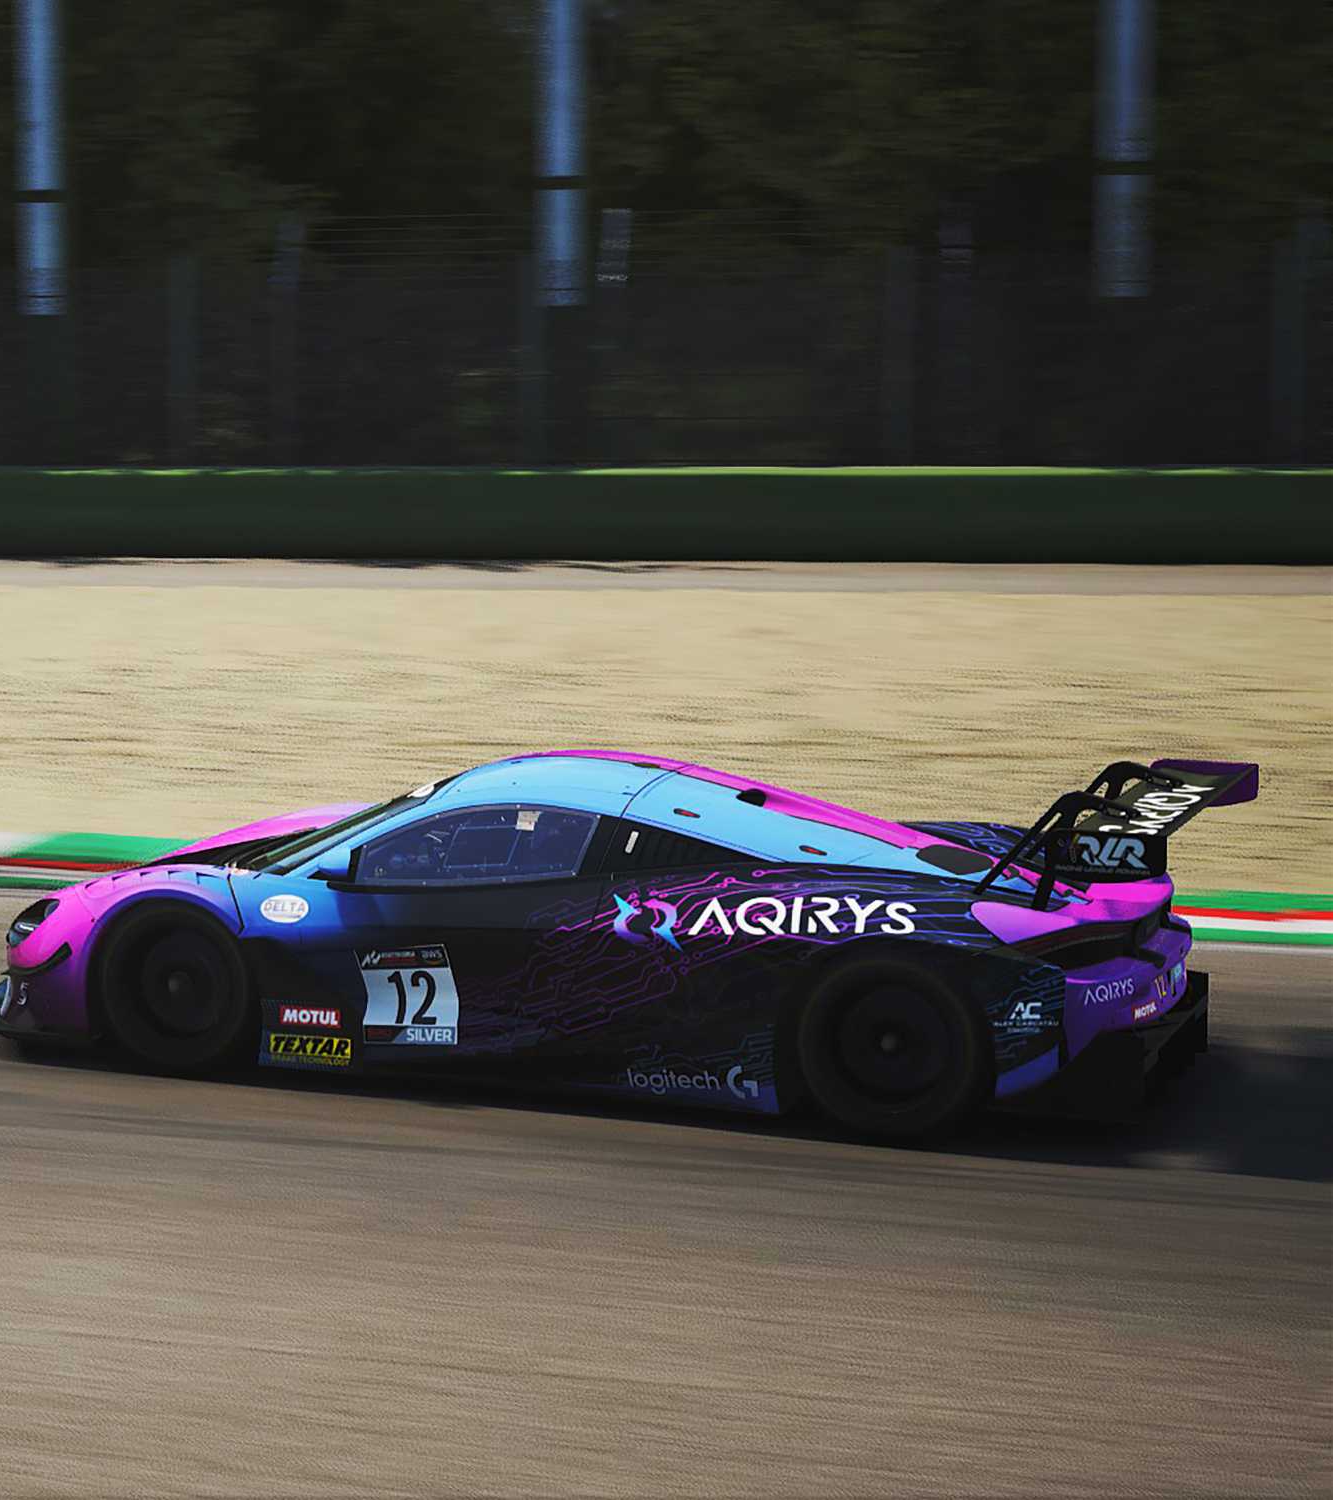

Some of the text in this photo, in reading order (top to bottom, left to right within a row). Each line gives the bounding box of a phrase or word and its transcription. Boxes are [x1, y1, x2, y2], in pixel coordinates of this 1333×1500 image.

[264, 901, 306, 912] DELTA
[687, 896, 917, 936] AQIRYS
[387, 971, 437, 1025] 12
[1084, 978, 1135, 1006] AQIRYS
[283, 1008, 338, 1025] MOTUL
[271, 1036, 349, 1056] TEXTAR
[406, 1028, 453, 1042] SILVER
[626, 1066, 759, 1098] logitech G
